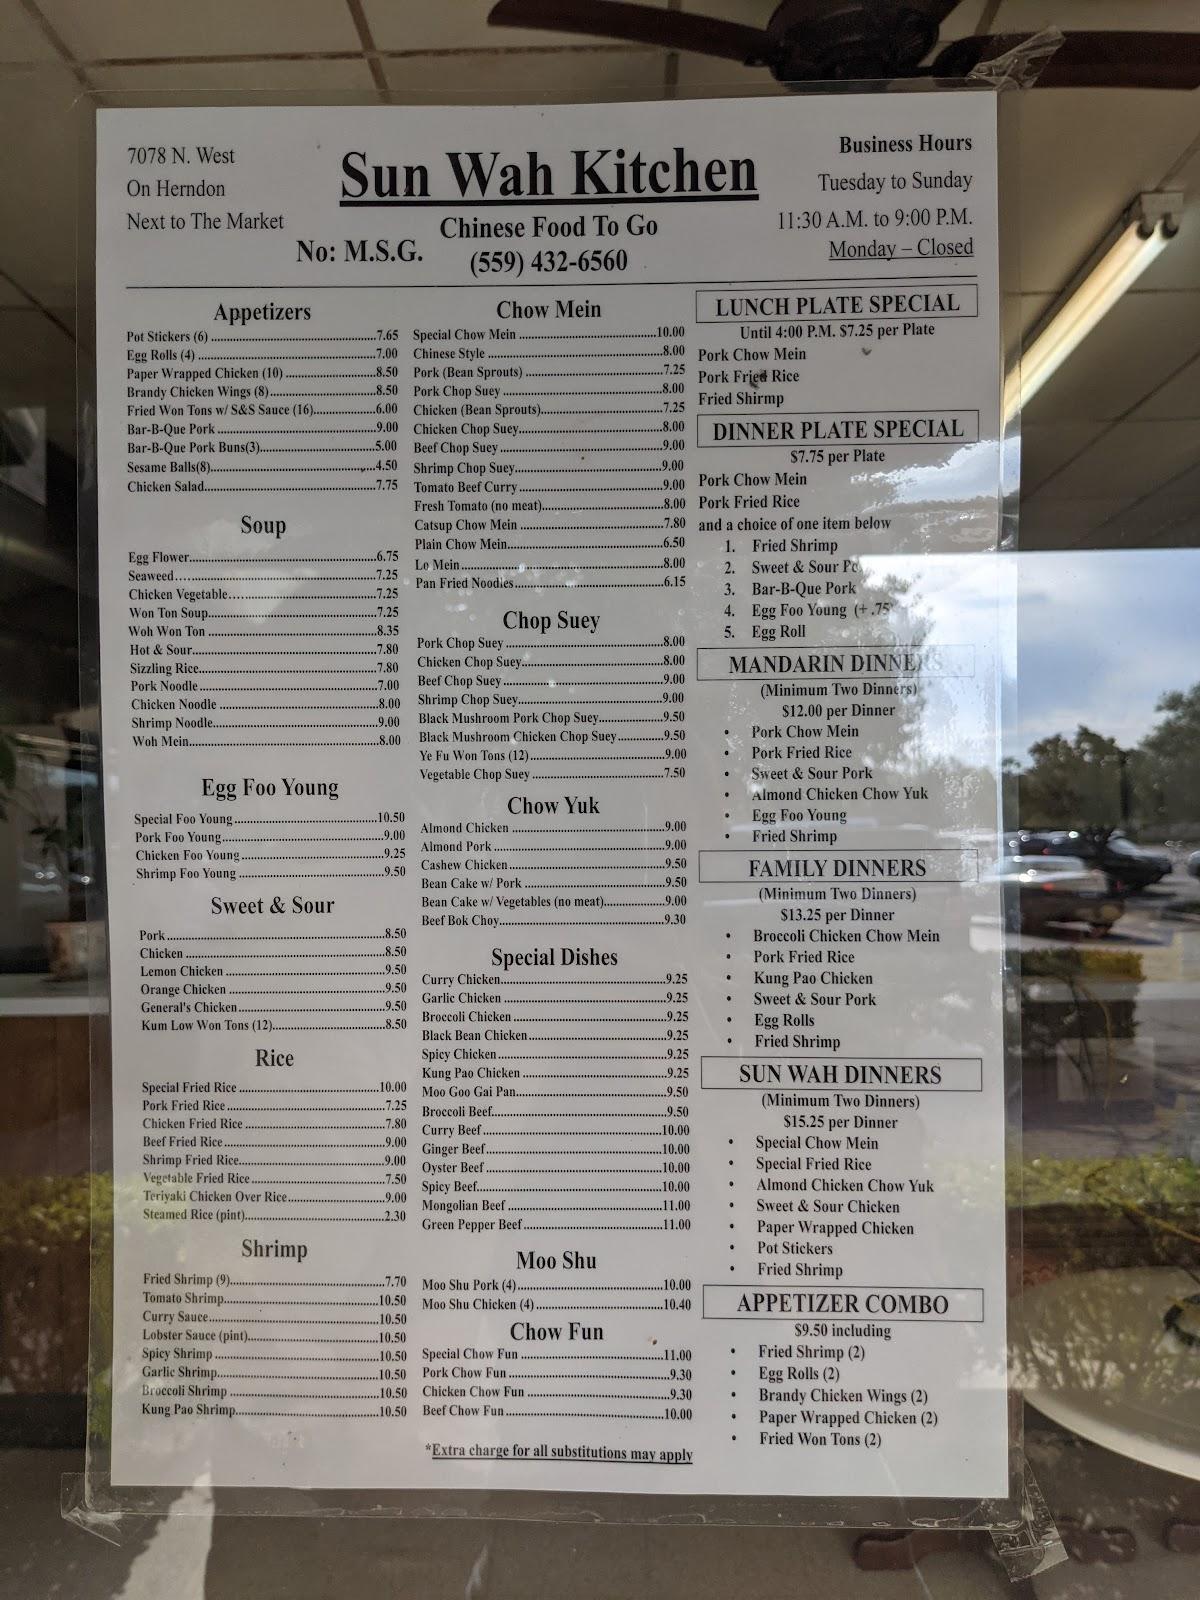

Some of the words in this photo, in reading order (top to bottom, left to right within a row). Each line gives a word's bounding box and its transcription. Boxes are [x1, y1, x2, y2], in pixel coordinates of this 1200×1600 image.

[839, 135, 912, 153] Business
[918, 134, 972, 151] Hours
[127, 146, 166, 164] 7078
[171, 146, 190, 164] N.
[195, 146, 234, 164] West
[341, 151, 430, 198] Sun
[444, 152, 554, 197] Wah
[570, 147, 757, 195] Kitchen
[126, 179, 150, 197] On
[157, 179, 224, 197] Herndon
[817, 172, 886, 195] Tuesday
[890, 173, 906, 189] to
[912, 170, 972, 193] Sunday
[127, 212, 165, 230] Next
[170, 215, 185, 230] to
[190, 212, 221, 230] The
[226, 211, 283, 230] Market
[439, 216, 524, 239] Chinese
[531, 215, 585, 238] Food
[592, 215, 619, 237] To
[626, 214, 657, 236] Go
[779, 210, 821, 230] 11:30
[825, 210, 867, 228] A.M.
[873, 211, 889, 228] to
[894, 208, 930, 226] 9:00
[935, 207, 972, 226] P.M.
[296, 240, 335, 262] No:
[344, 239, 422, 262] M.S.G.
[829, 239, 896, 260] Monday
[917, 237, 973, 255] Closed
[470, 251, 523, 278] (559)
[530, 250, 627, 272] 432-6560
[213, 302, 310, 326] Appetizers
[496, 300, 549, 320] Chow
[555, 300, 601, 318] Mein
[715, 298, 789, 316] LUNCH
[796, 296, 862, 315] PLATE
[869, 293, 959, 313] SPECIAL
[127, 331, 143, 342] Pot
[147, 330, 190, 342] Stickers
[193, 331, 208, 345] (6)
[740, 325, 771, 339] Until
[775, 324, 802, 339] 4:00
[807, 324, 835, 338] P.M.
[839, 323, 873, 338] $7.25
[877, 326, 898, 340] per
[902, 322, 934, 336] Plate
[413, 347, 455, 359] Chinese
[458, 347, 484, 361] Style
[127, 368, 158, 382] Paper
[161, 367, 211, 382] Wrapped
[214, 367, 258, 379] Chicken
[262, 367, 282, 380] (10)
[698, 392, 732, 406] Fried
[736, 391, 784, 408] Shirmp
[127, 423, 185, 438] Bar-B-Que
[189, 423, 215, 435] Pork
[713, 422, 794, 440] DINNER
[801, 420, 867, 440] PLATE
[873, 419, 963, 439] SPECIAL
[790, 449, 823, 464] $7.75
[827, 453, 849, 467] per
[853, 449, 885, 462] Plate
[240, 515, 286, 539] Soup
[414, 520, 452, 534] Catsup
[455, 519, 486, 531] Chow
[490, 518, 517, 531] Mein
[128, 626, 153, 637] Woh
[156, 625, 181, 637] Won
[184, 625, 204, 637] Ton
[502, 610, 551, 635] Chop
[557, 610, 600, 634] Suey
[131, 680, 157, 692] Pork
[160, 680, 197, 692] Noodle
[201, 779, 236, 802] Egg
[243, 778, 275, 796] Foo
[281, 778, 338, 801] Young
[507, 797, 558, 815] Chow
[564, 796, 600, 814] Yuk
[749, 859, 827, 877] FAMILY
[832, 859, 926, 877] DINNERS
[211, 897, 263, 915] Sweet
[269, 896, 286, 914] &
[292, 896, 335, 914] Sour
[753, 929, 805, 942] Broccoli
[808, 928, 861, 942] Chicken
[865, 928, 902, 942] Chow
[907, 928, 939, 942] Mein
[491, 948, 555, 972] Special
[560, 948, 617, 966] Dishes
[754, 971, 789, 988] Kung
[792, 971, 816, 984] Pao
[820, 971, 872, 984] Chicken
[140, 983, 180, 997] Orange
[182, 983, 225, 994] Chicken
[255, 1048, 293, 1067] Rice
[739, 1064, 781, 1083] SUN
[787, 1064, 838, 1083] WAH
[844, 1065, 941, 1085] DINNERS
[142, 1081, 179, 1096] Special
[182, 1081, 210, 1093] Fried
[213, 1081, 236, 1093] Rice
[756, 1157, 801, 1174] Special
[805, 1157, 839, 1170] Fried
[844, 1157, 871, 1171] Rice
[756, 1178, 807, 1191] Almond
[810, 1177, 863, 1191] Chicken
[867, 1179, 904, 1193] Chow
[908, 1180, 933, 1193] Yuk
[422, 1199, 478, 1214] Mongolian
[482, 1199, 506, 1210] Beef
[241, 1239, 307, 1263] Shrimp
[516, 1251, 556, 1269] Moo
[562, 1250, 596, 1269] Shu
[736, 1293, 859, 1312] APPETIZER
[865, 1294, 948, 1314] COMBO
[510, 1322, 562, 1341] Chow
[569, 1322, 603, 1340] Fun
[794, 1322, 827, 1337] $9.50
[831, 1324, 891, 1341] including
[141, 1347, 170, 1362] Spicy
[173, 1347, 212, 1363] Shrimp
[759, 1387, 806, 1405] Brandy
[810, 1389, 862, 1403] Chicken
[866, 1389, 906, 1407] Wings
[910, 1389, 927, 1406] (2)
[759, 1432, 793, 1446] Fried
[797, 1432, 826, 1446] Won
[830, 1432, 860, 1446] Tons
[864, 1432, 881, 1448] (2)
[469, 1443, 509, 1459] charge
[512, 1444, 530, 1459] for
[533, 1444, 547, 1457] all
[551, 1445, 626, 1459] substitutions
[630, 1451, 655, 1463] may
[659, 1448, 692, 1463] apply
